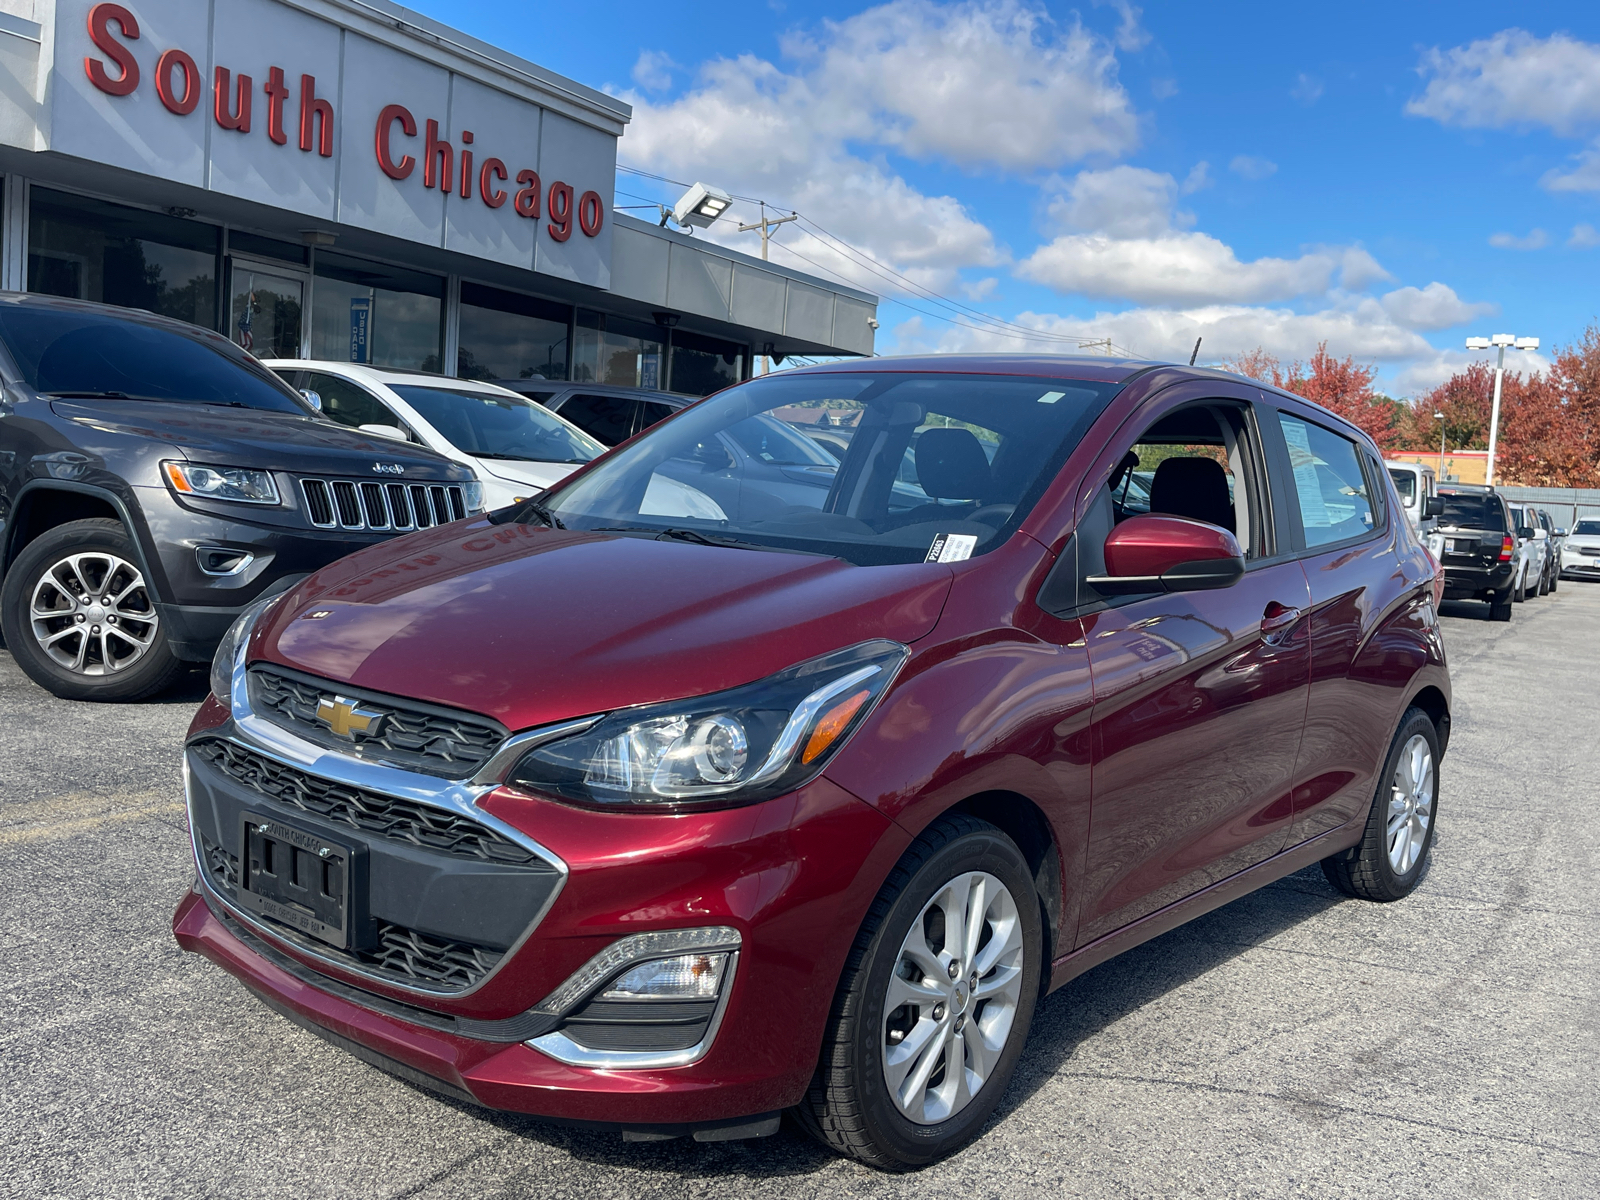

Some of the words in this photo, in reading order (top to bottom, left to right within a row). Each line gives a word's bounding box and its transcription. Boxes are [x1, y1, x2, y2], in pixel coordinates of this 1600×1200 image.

[84, 3, 334, 158] South
[375, 104, 604, 243] Chicago
[372, 462, 405, 475] Jeep
[267, 822, 290, 840] SOUTH
[290, 831, 321, 851] CHICAGO
